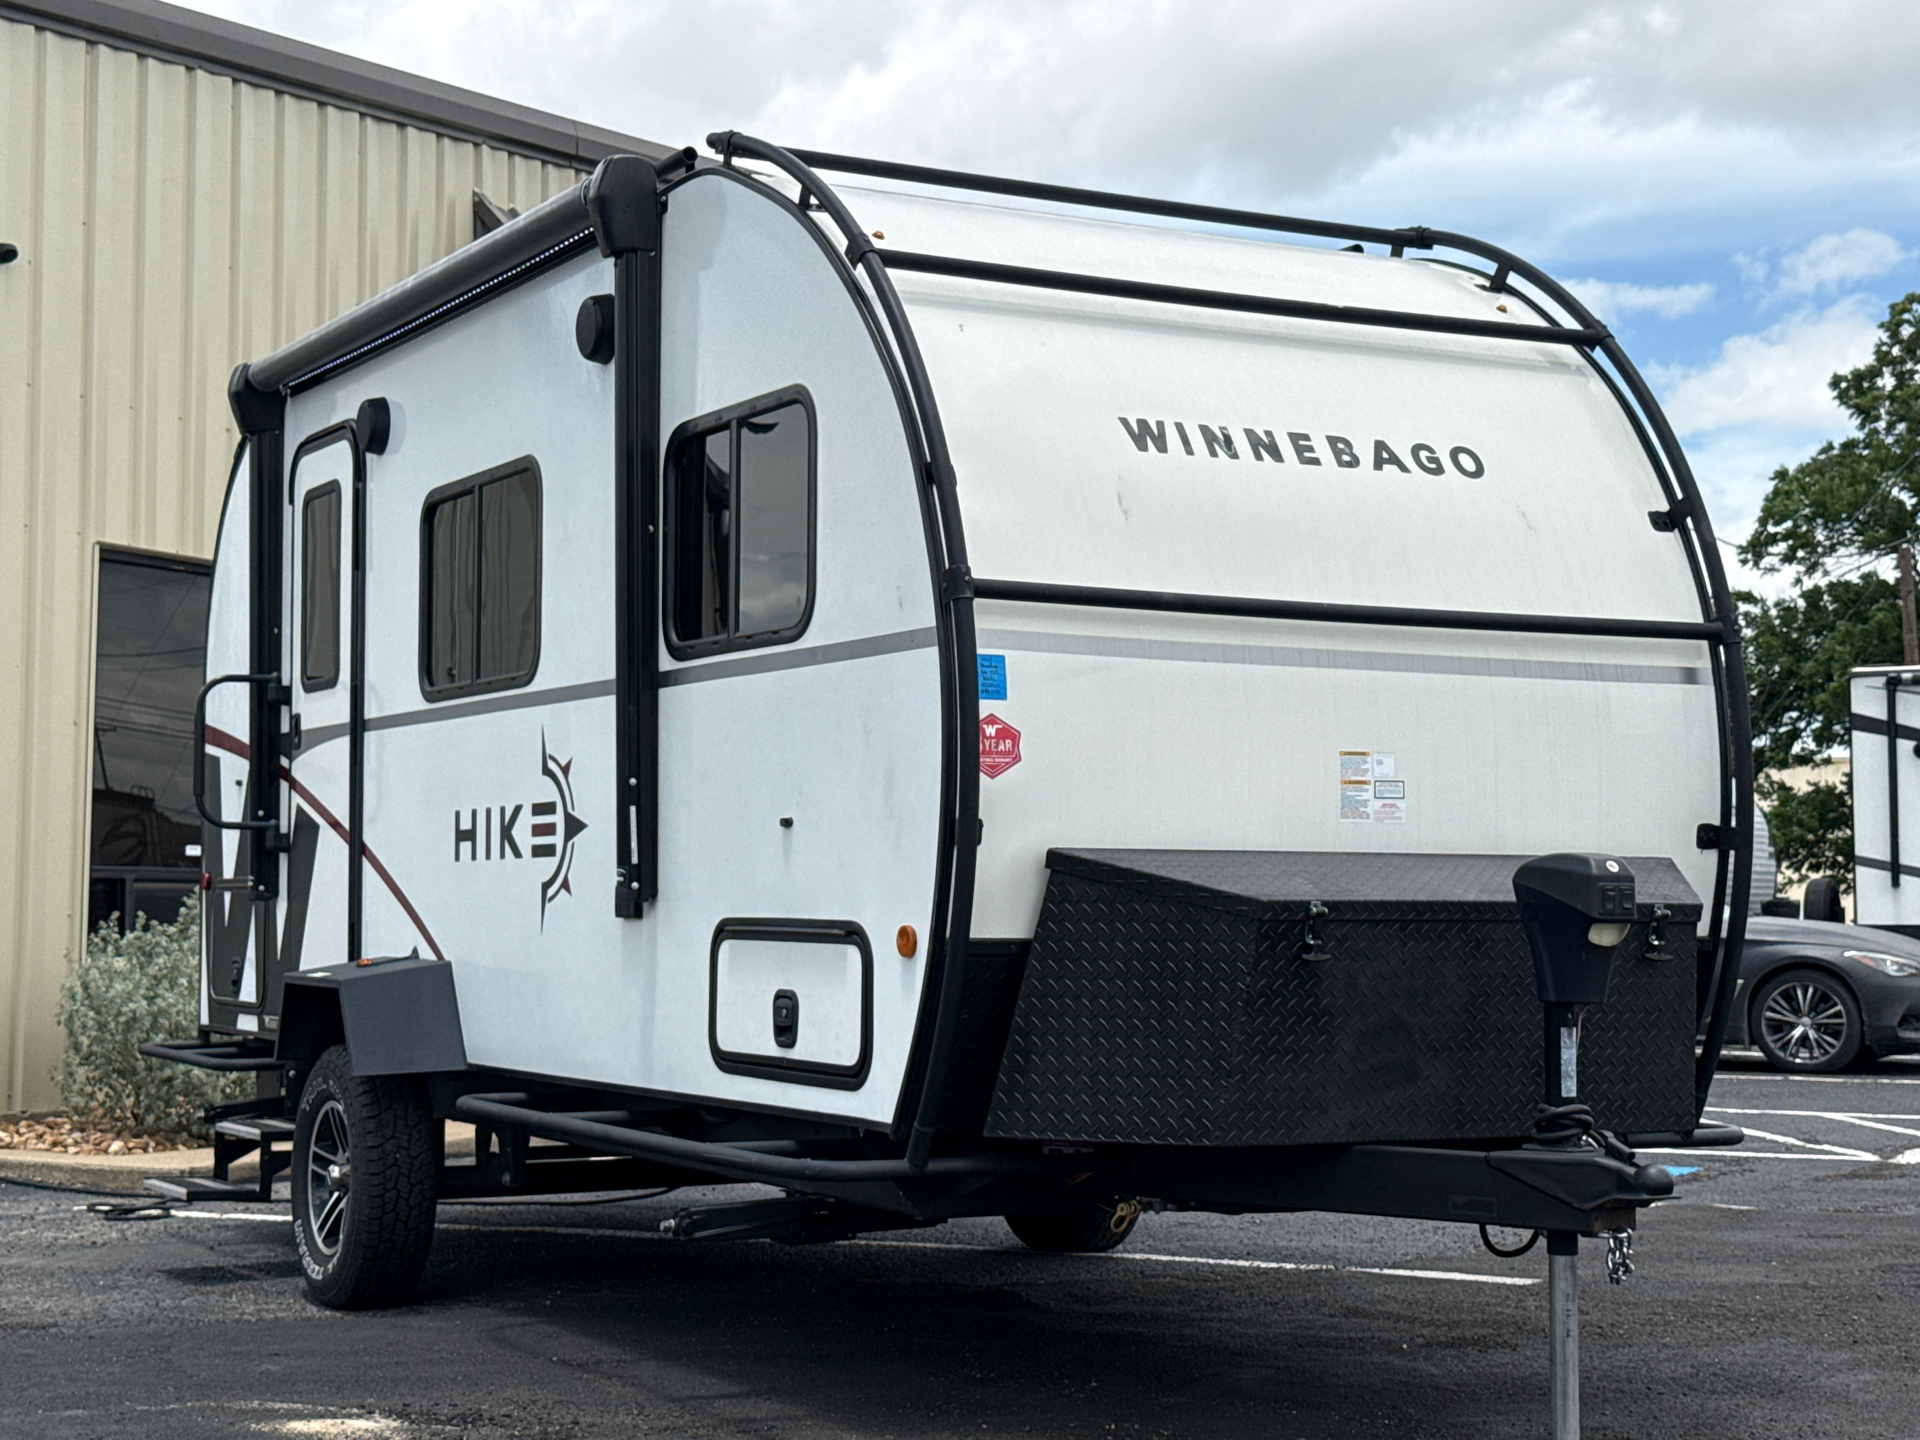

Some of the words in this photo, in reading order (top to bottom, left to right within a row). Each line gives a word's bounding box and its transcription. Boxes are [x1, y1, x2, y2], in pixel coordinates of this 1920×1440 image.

[1117, 416, 1486, 479] WINNEBAGO
[983, 739, 1013, 752] YEAR
[454, 800, 557, 863] HIKE
